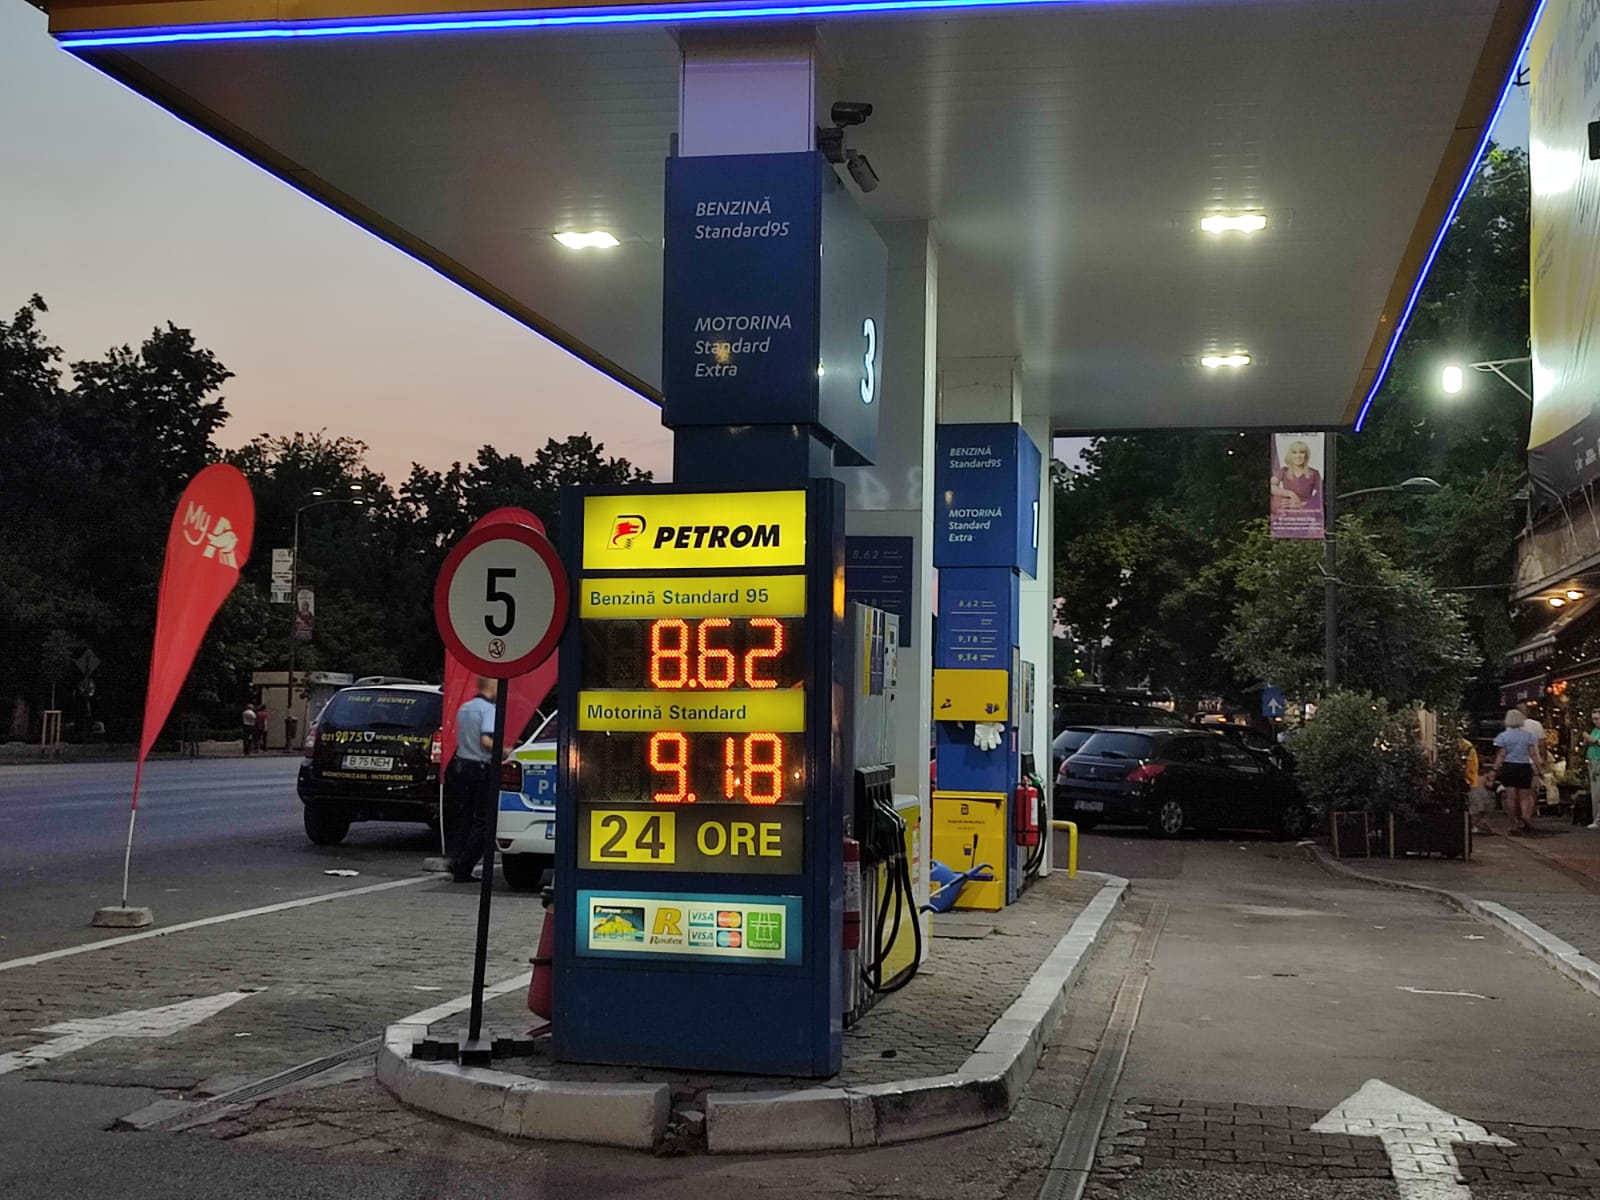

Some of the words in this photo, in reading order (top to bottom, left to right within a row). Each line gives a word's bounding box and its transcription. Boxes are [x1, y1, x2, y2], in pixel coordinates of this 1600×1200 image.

[695, 196, 772, 217] BENZINĂ
[695, 221, 790, 239] Standard95
[694, 314, 792, 332] MOTORINA
[694, 336, 771, 355] Standard
[694, 363, 738, 377] Extra
[861, 318, 876, 404] 3
[949, 520, 991, 531] Standard
[653, 524, 780, 549] PETROM
[949, 533, 974, 543] Extra
[484, 568, 517, 637] 5
[591, 590, 656, 606] Benzină
[663, 589, 739, 605] Standard
[746, 588, 769, 602] 95
[650, 617, 784, 689] 8.62
[588, 704, 662, 719] Motorină
[669, 704, 746, 719] Standard
[349, 756, 357, 766] B
[359, 757, 369, 766] 75
[650, 732, 782, 804] 9.18
[600, 815, 665, 859] 24
[697, 821, 782, 857] ORE
[692, 912, 714, 921] VISA
[691, 932, 713, 940] VISA
